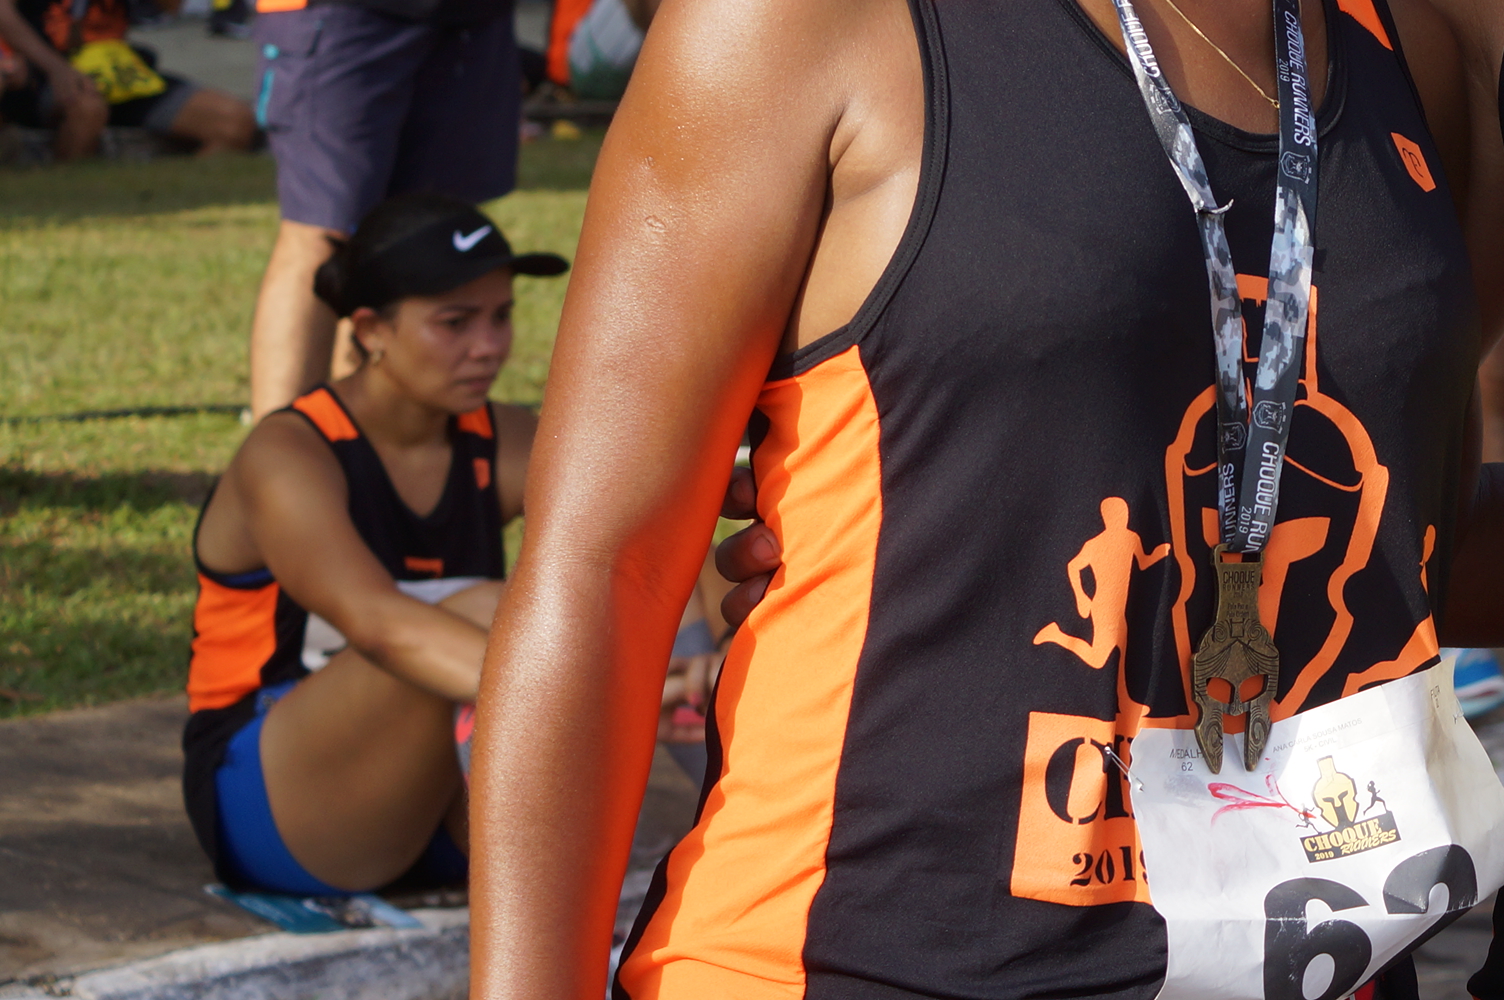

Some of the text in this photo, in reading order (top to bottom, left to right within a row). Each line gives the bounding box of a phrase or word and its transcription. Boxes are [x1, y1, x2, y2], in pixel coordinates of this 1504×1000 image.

[1279, 58, 1290, 82] 2019
[1284, 10, 1311, 147] CHOQUE RUNNERS
[1254, 441, 1280, 517] CHOQUE
[1239, 506, 1252, 534] 2019
[1223, 571, 1255, 584] CHOQUE
[1223, 583, 1255, 591] RUNNERS
[1272, 718, 1363, 753] ANA CARLA SOUSA MATOS
[1318, 738, 1337, 748] CIVIL
[1169, 749, 1204, 759] MEDALH
[1181, 762, 1193, 772] 62
[1303, 818, 1382, 852] CHOQUE
[1315, 829, 1396, 860] 2019 RUNNERS
